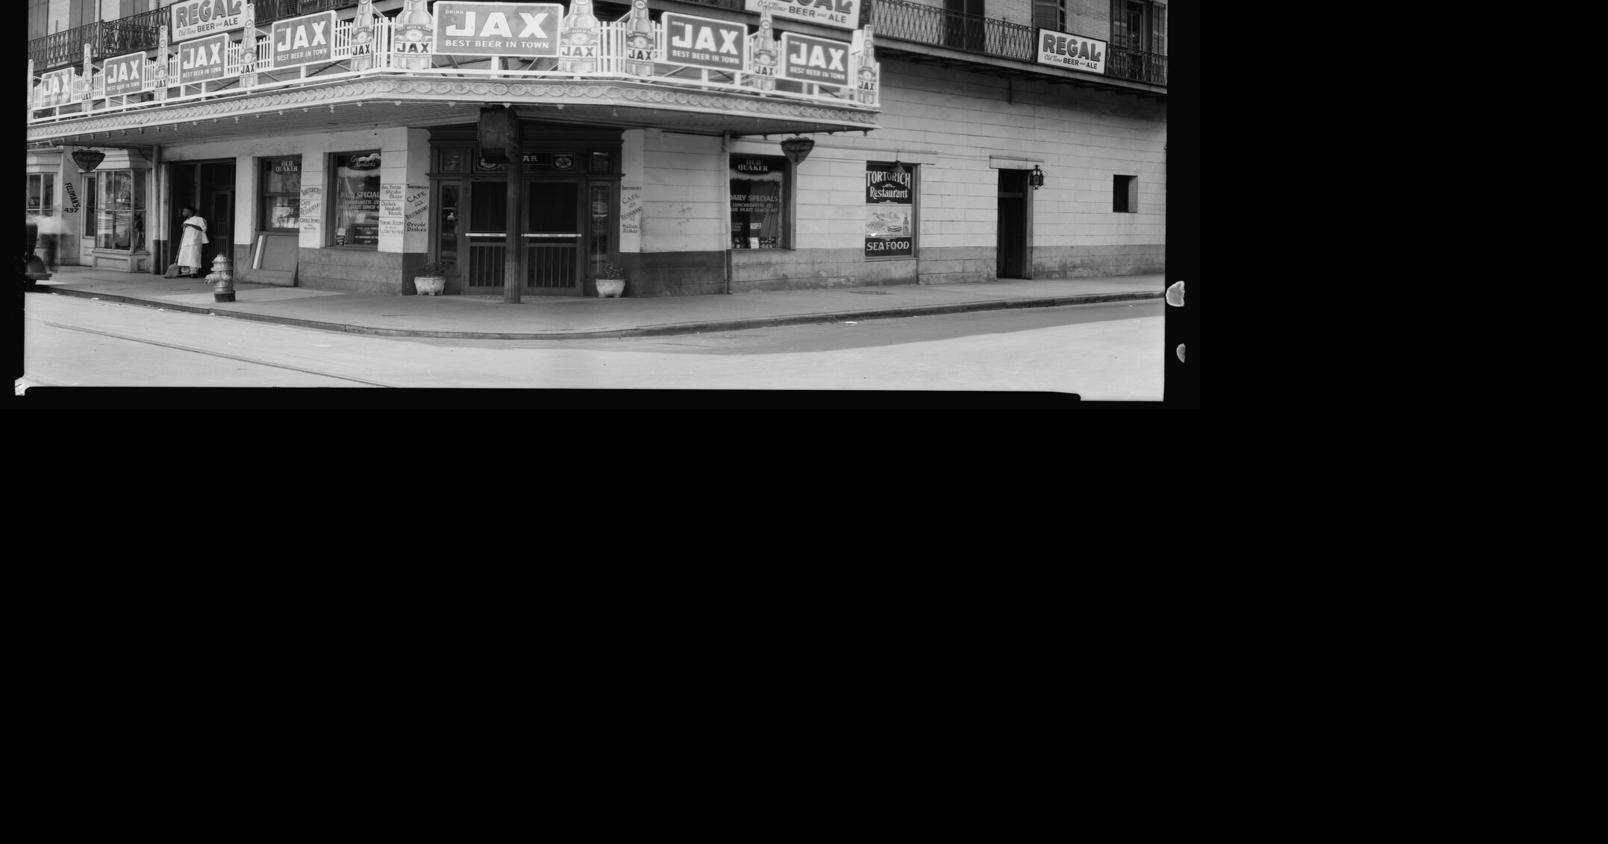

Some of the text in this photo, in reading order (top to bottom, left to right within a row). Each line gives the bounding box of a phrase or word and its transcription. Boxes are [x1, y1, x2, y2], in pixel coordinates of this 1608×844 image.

[176, 0, 242, 29] REGAL
[788, 6, 816, 17] BEER
[828, 14, 846, 23] ALE
[197, 23, 215, 32] BEER
[224, 18, 239, 27] ALE
[446, 11, 549, 38] JAX
[277, 21, 327, 52] JAX
[672, 23, 738, 55] JAX
[277, 54, 289, 62] BEST
[290, 52, 304, 60] BEER
[313, 48, 327, 56] TOWN
[352, 44, 370, 56] JAX
[397, 43, 429, 53] JAX
[562, 47, 595, 57] JAX
[629, 49, 652, 60] JAX
[1043, 34, 1101, 63] REGAL
[183, 42, 222, 69] JAX
[672, 50, 690, 58] BEST
[692, 52, 710, 60] BEER
[721, 56, 739, 64] TOWN
[790, 43, 845, 71] JAX
[1063, 57, 1080, 66] BEER
[108, 60, 139, 84] JAX
[241, 63, 255, 73] JAX
[755, 66, 774, 76] JAX
[806, 68, 821, 76] BEER
[44, 73, 71, 96] JAX
[155, 80, 166, 88] JAX
[859, 81, 874, 90] JAX
[737, 164, 768, 172] QUAKER
[866, 170, 911, 190] TORTORICH
[870, 186, 908, 199] Restaurant
[867, 241, 910, 251] SEA FOOD
